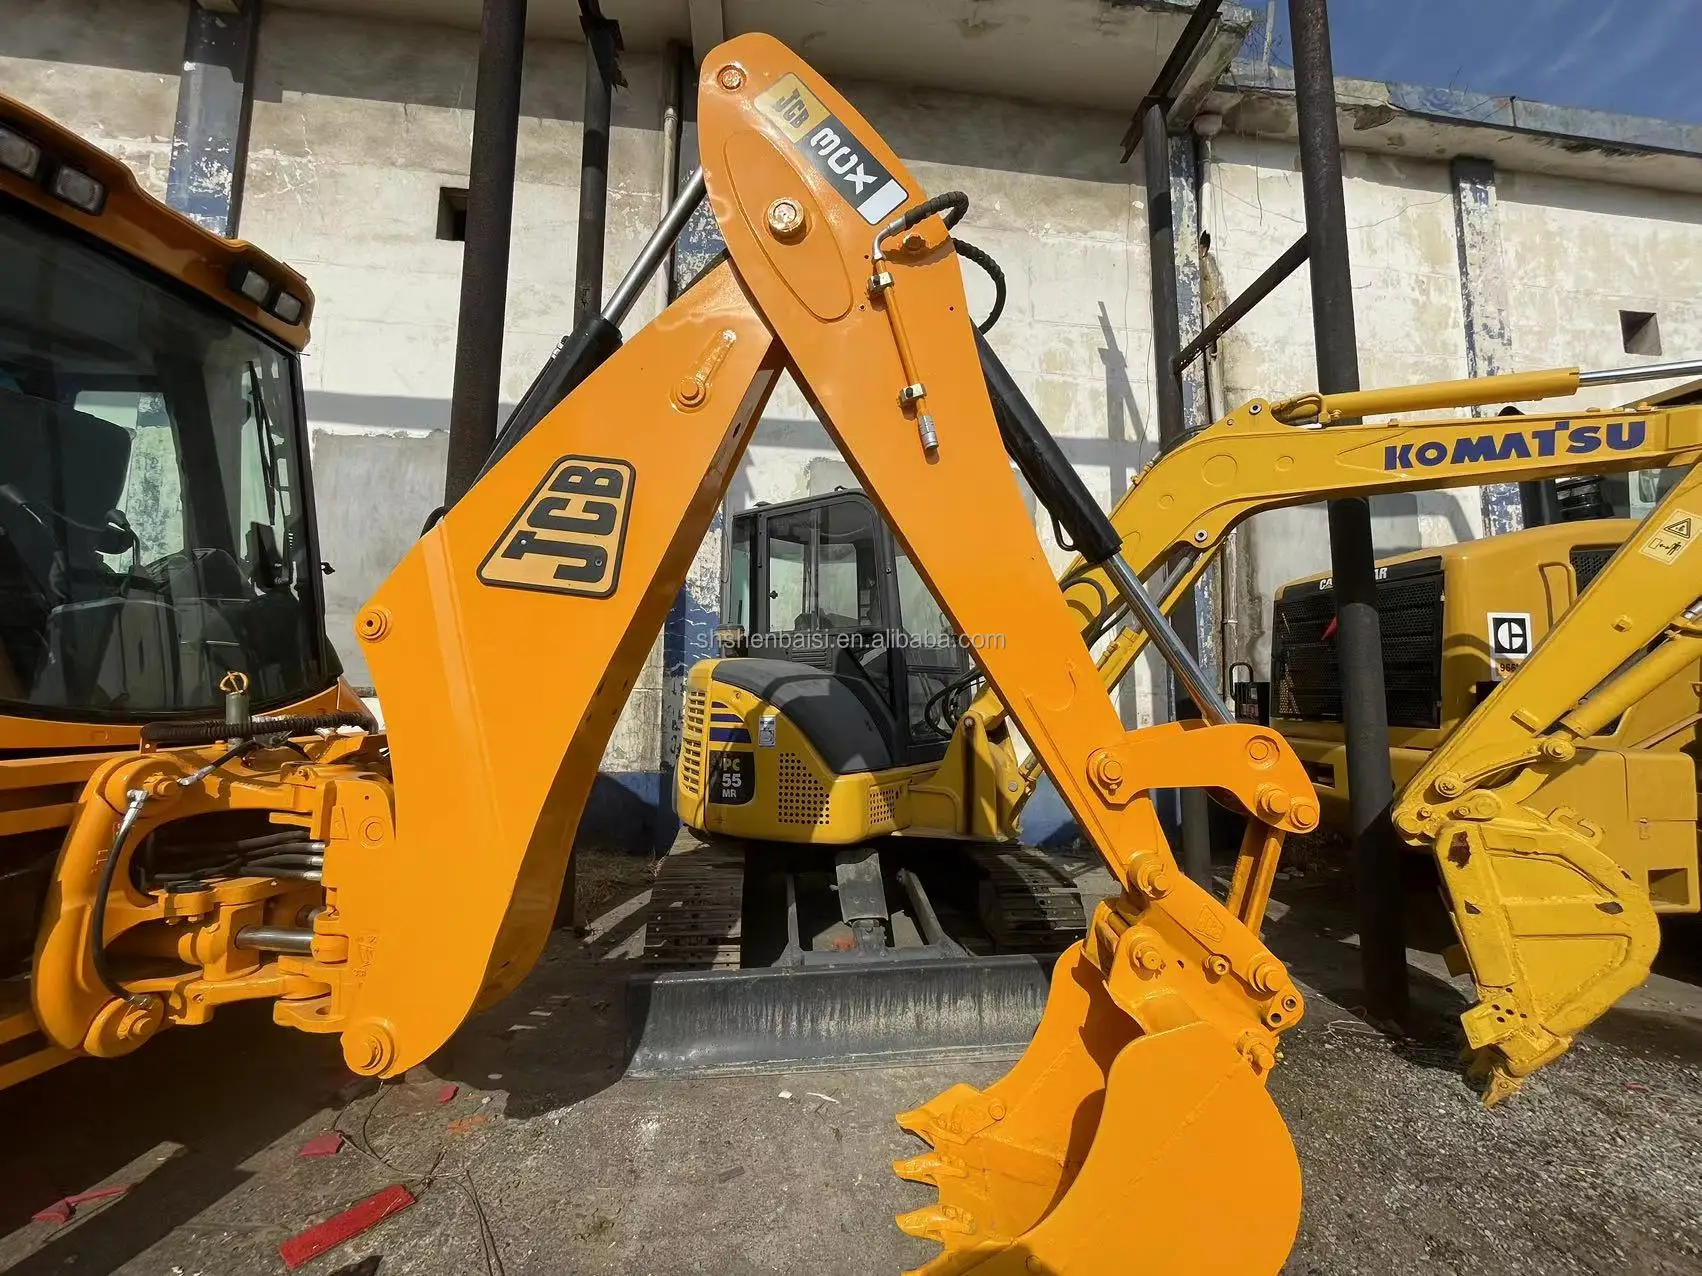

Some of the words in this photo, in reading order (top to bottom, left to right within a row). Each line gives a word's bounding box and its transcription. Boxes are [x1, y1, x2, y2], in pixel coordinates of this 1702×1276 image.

[773, 88, 810, 128] JCB
[810, 127, 878, 195] 3CX
[1384, 420, 1646, 470] KOMATSU
[501, 465, 624, 583] JCB
[721, 773, 742, 787] 55
[723, 757, 741, 771] PC
[722, 788, 737, 798] MR
